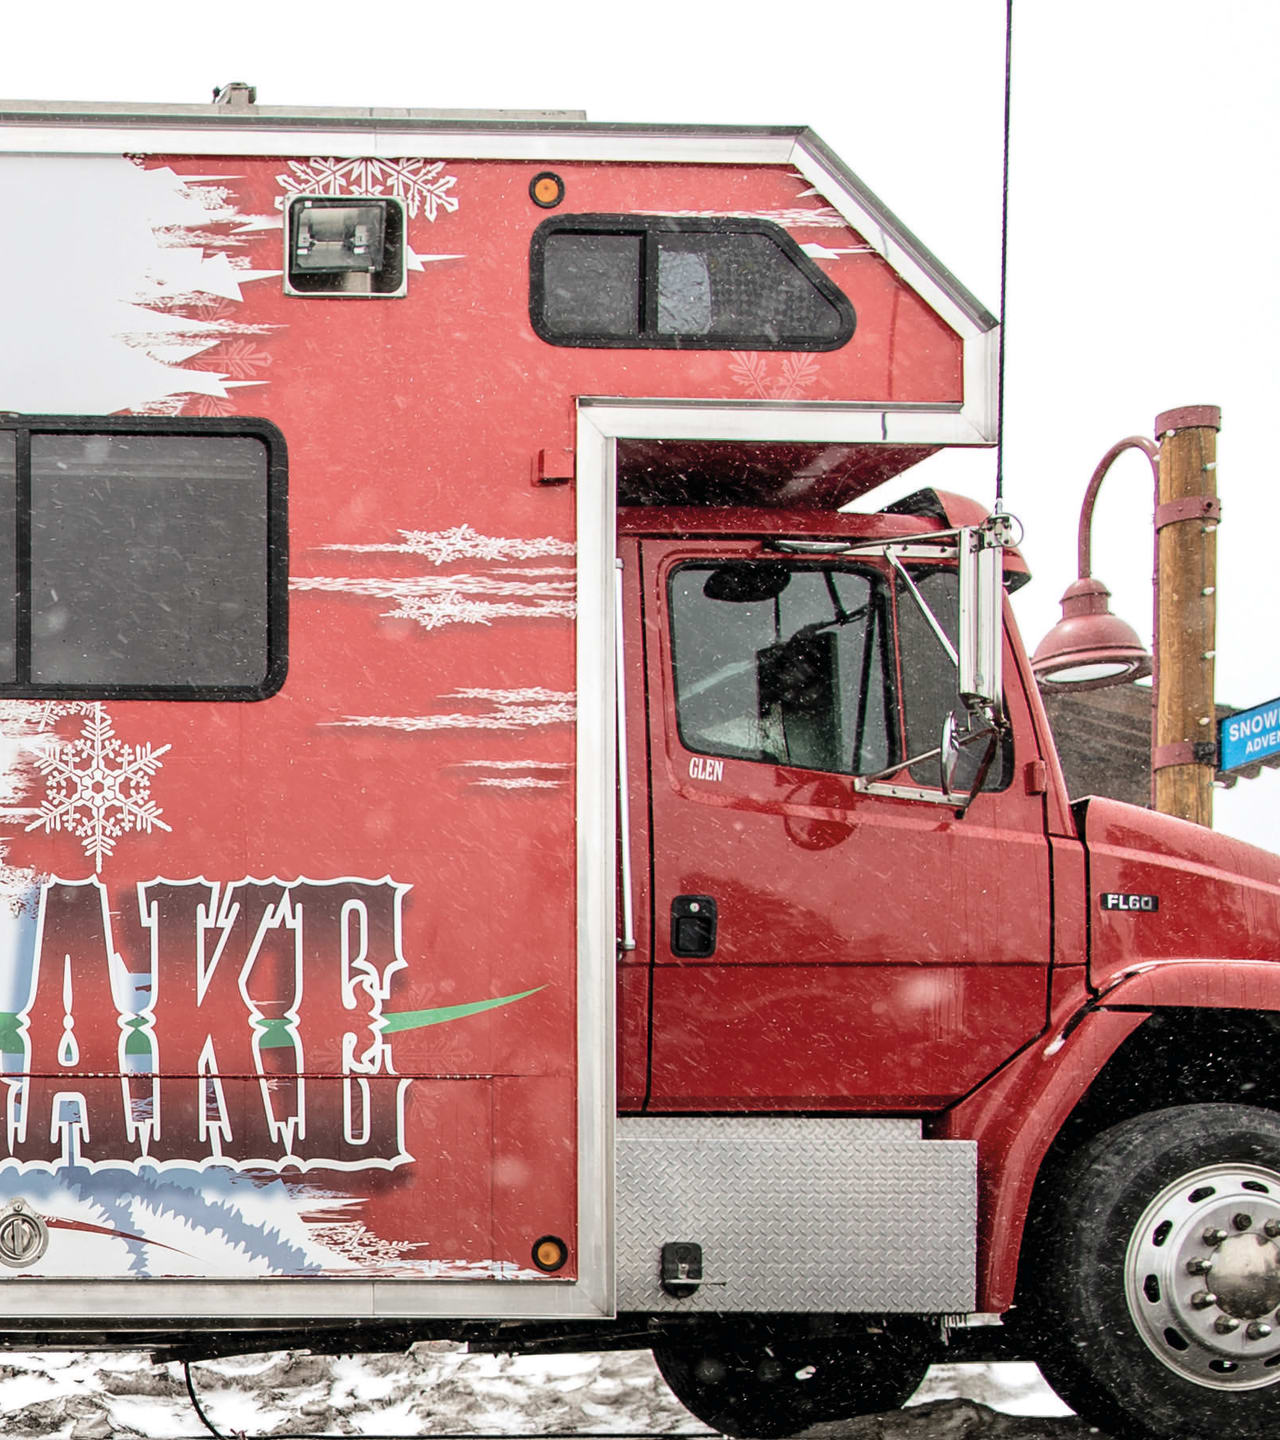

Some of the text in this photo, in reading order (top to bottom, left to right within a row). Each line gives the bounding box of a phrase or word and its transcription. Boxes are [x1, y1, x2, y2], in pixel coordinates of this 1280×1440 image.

[1229, 708, 1280, 742] SNOW
[688, 757, 725, 781] GLEN
[1107, 894, 1153, 910] FL60
